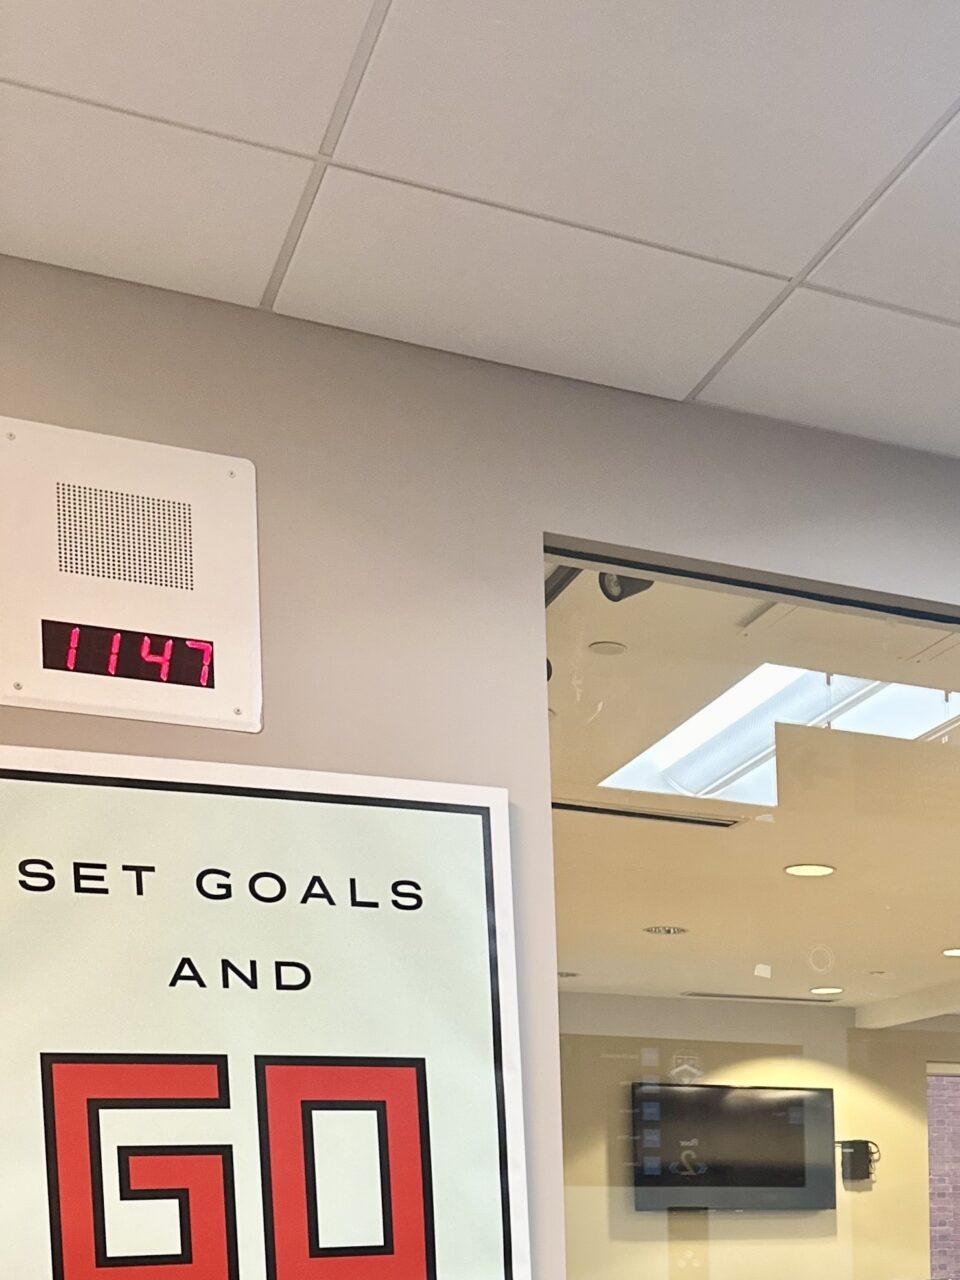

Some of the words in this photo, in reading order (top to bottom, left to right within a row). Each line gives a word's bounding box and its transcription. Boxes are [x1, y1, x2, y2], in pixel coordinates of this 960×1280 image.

[66, 626, 213, 687] 1147
[17, 857, 156, 897] SET
[195, 867, 424, 912] GOALS
[168, 957, 312, 991] AND
